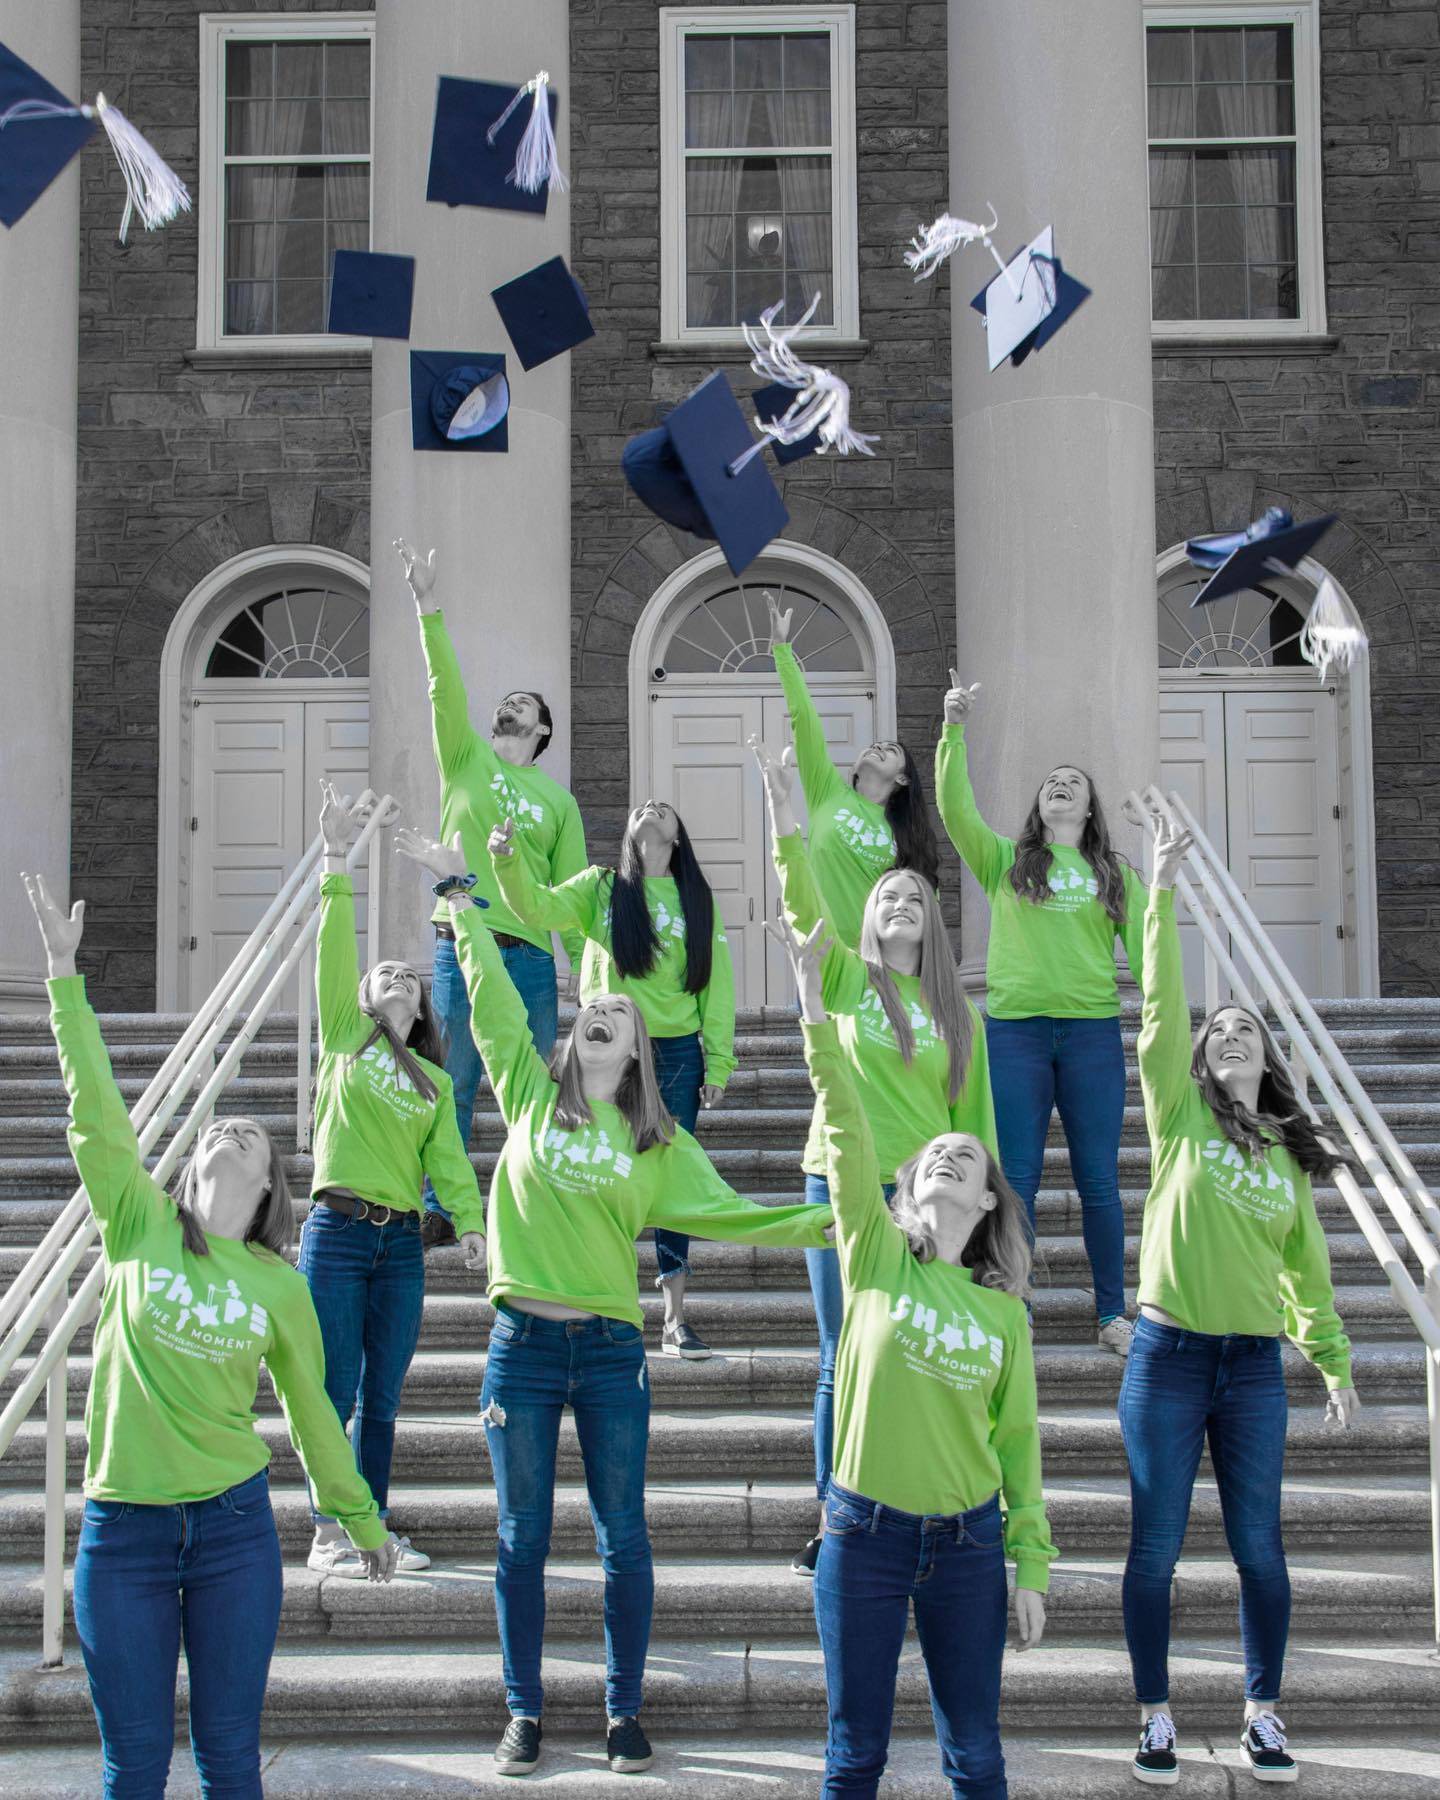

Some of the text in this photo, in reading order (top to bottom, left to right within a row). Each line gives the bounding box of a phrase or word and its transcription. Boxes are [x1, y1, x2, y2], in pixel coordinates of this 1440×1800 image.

[1057, 895, 1091, 903] OMENT
[564, 1167, 615, 1187] MOMENT
[1207, 1165, 1228, 1183] THE
[1241, 1189, 1291, 1213] MOMENT
[145, 1301, 253, 1351] THE MOMENT
[895, 1330, 993, 1377] THE MOMENT
